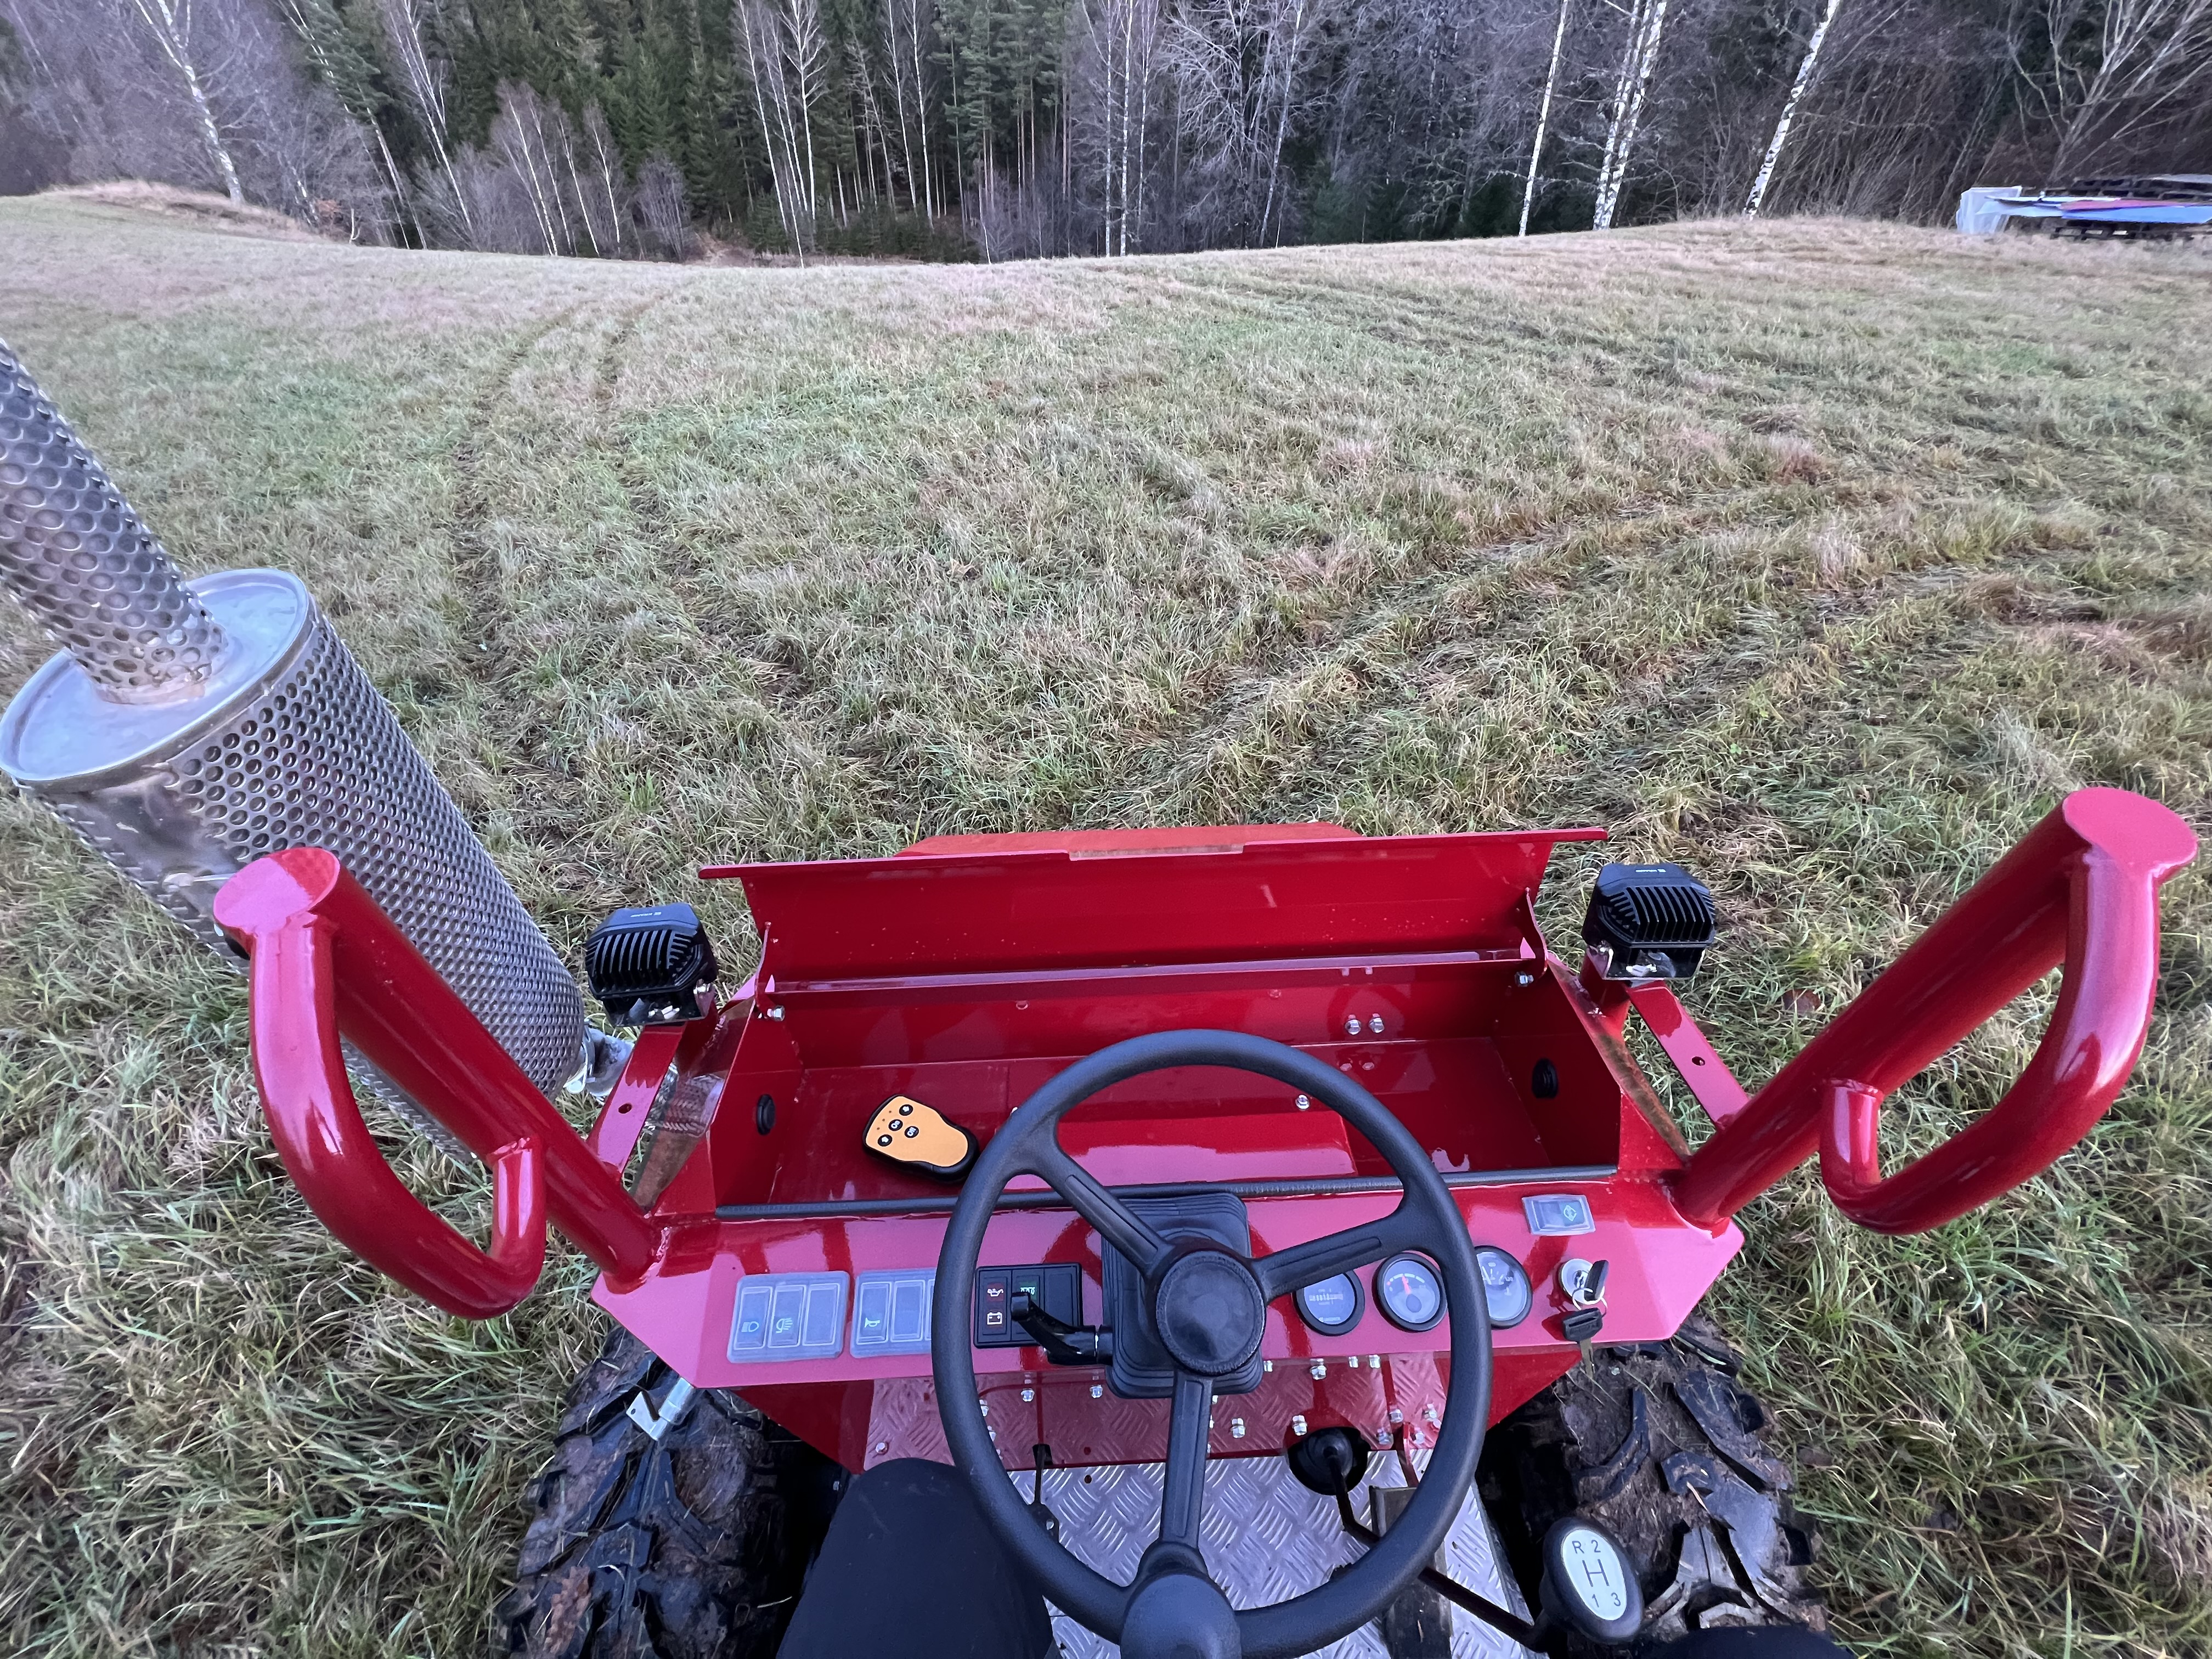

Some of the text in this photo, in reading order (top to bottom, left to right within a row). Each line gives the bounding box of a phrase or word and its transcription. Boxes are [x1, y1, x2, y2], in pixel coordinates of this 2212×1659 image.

[891, 1120, 900, 1129] On
[1572, 1539, 1601, 1554] R 2
[1592, 1592, 1621, 1608] 1 3
